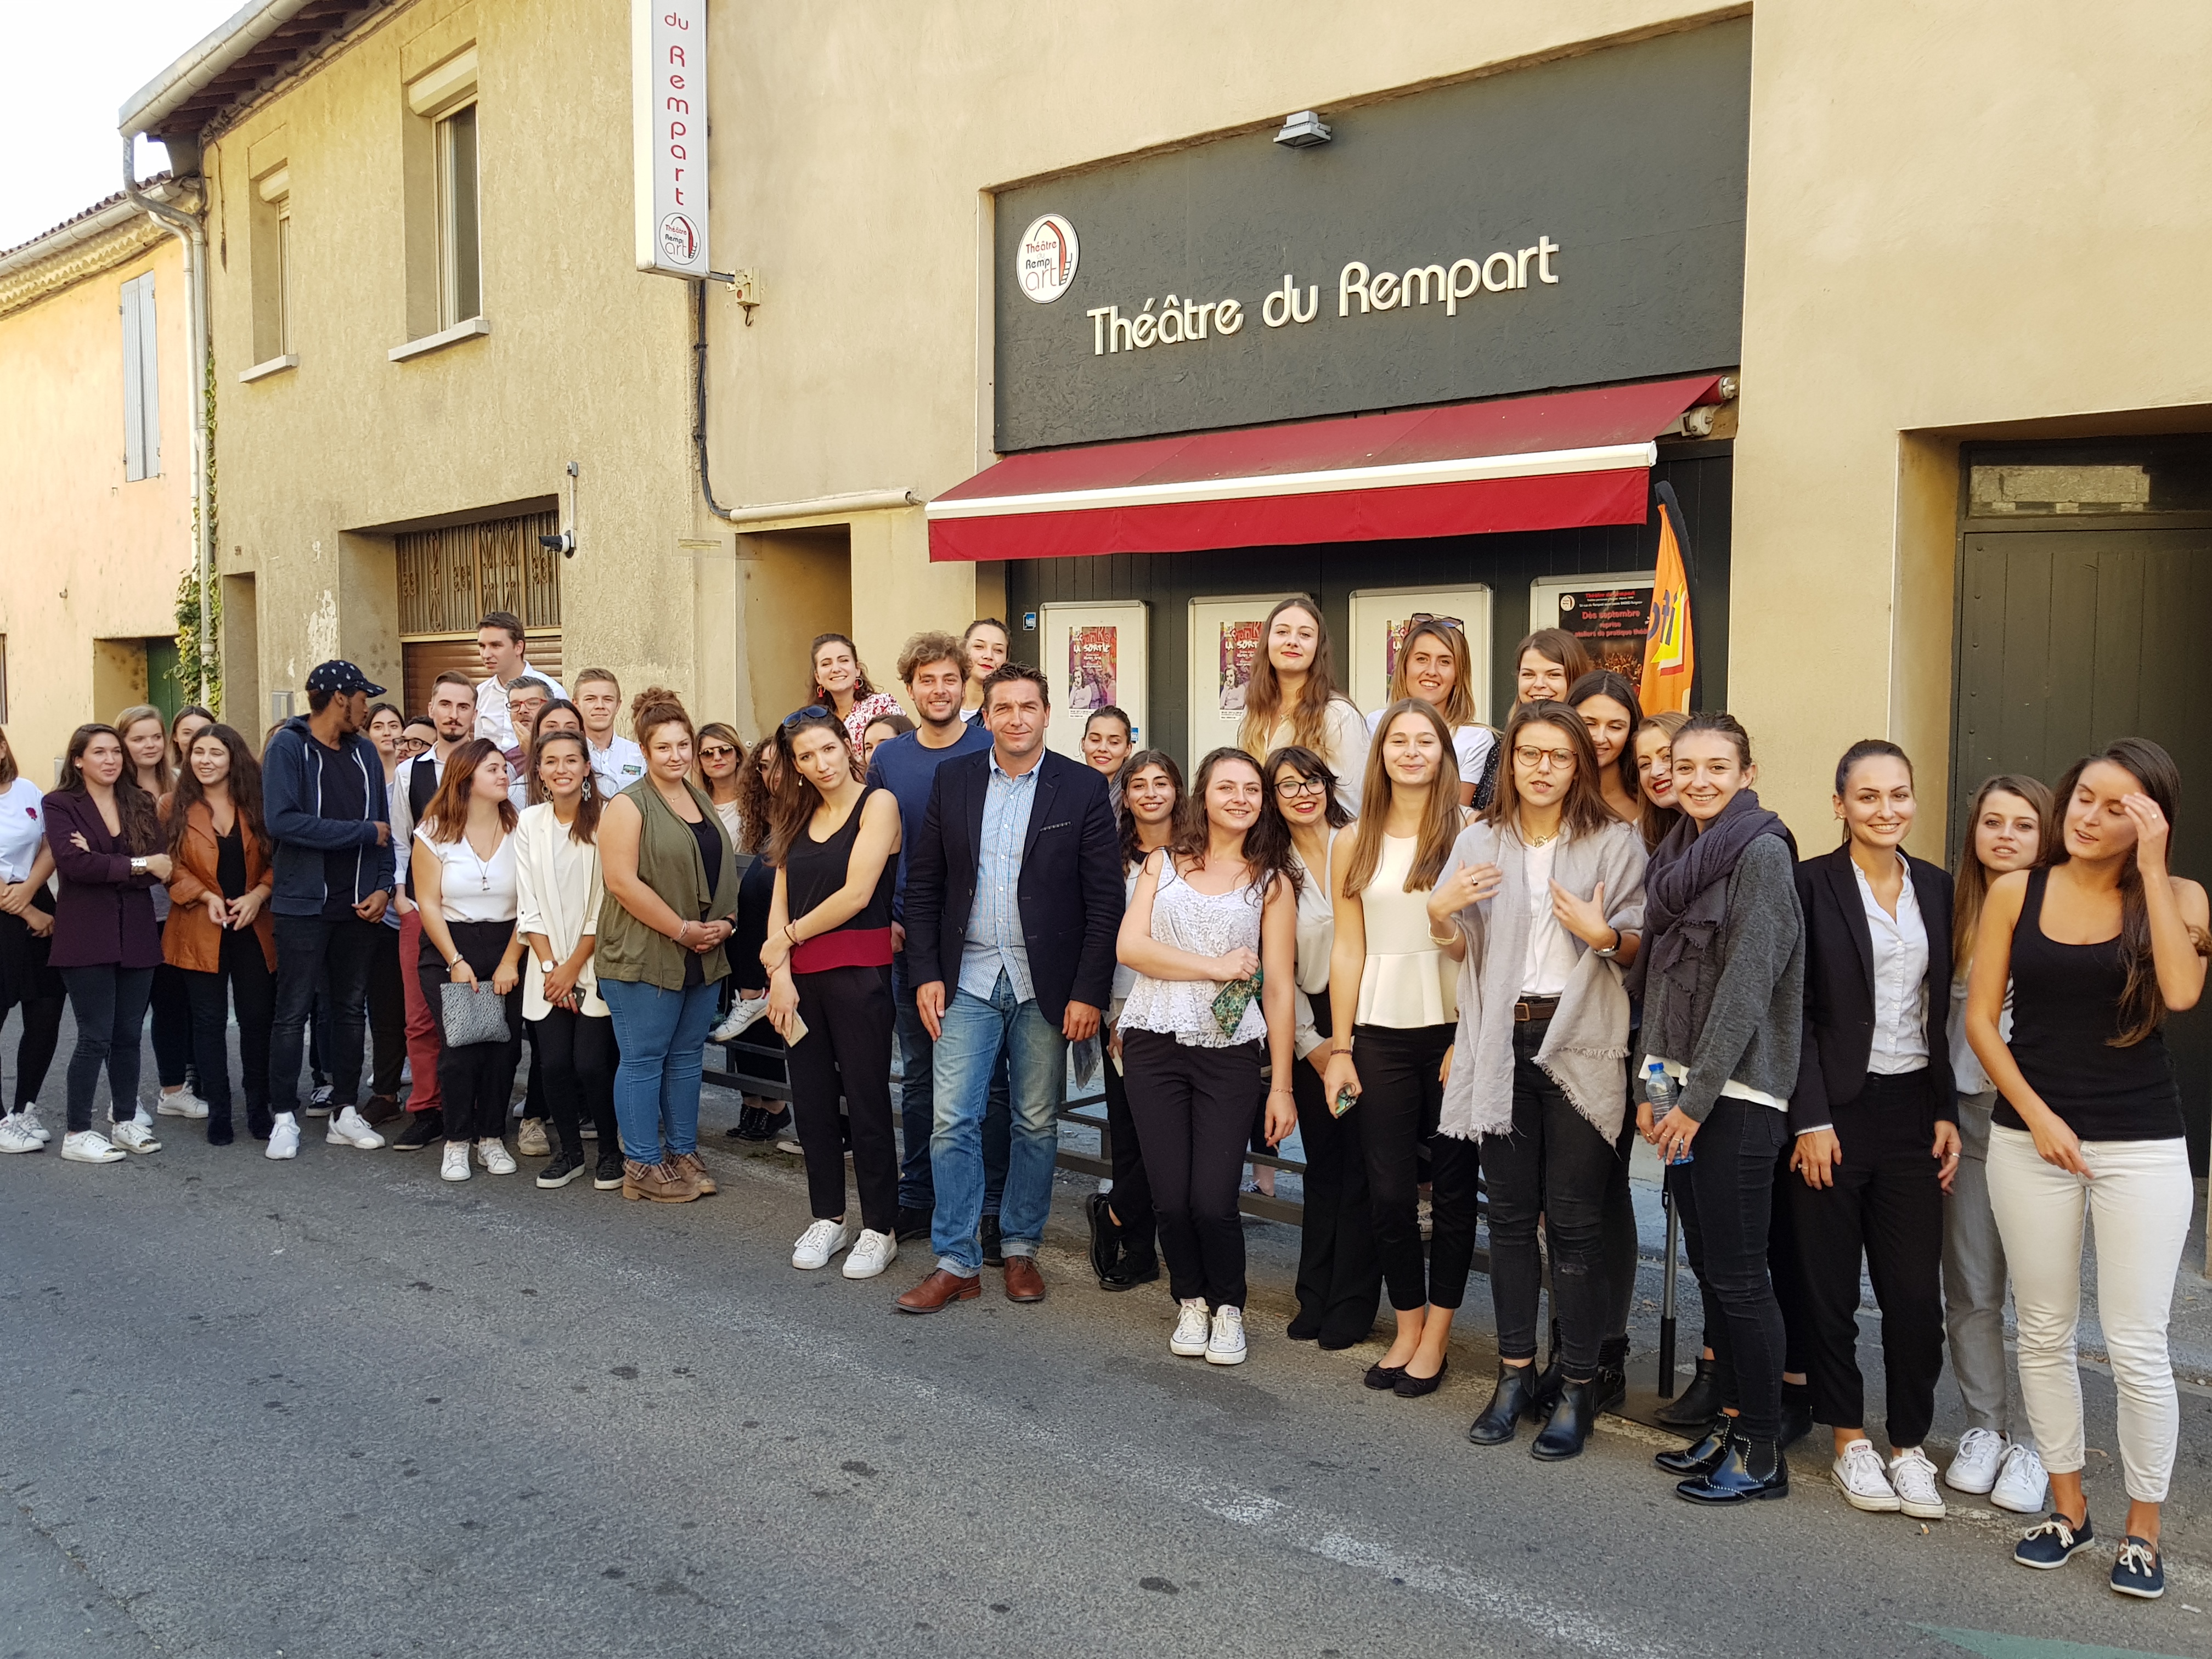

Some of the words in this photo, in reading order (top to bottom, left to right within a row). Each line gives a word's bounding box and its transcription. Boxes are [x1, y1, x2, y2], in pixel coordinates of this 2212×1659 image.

[664, 12, 689, 30] du
[667, 45, 689, 206] Rempart
[1026, 240, 1057, 254] Théâtre
[1026, 258, 1050, 269] Remp
[1025, 258, 1057, 291] art
[1087, 294, 1244, 356] Théâtre
[1262, 274, 1319, 328] du
[1339, 235, 1560, 317] Rempart
[1582, 611, 1597, 619] Dès
[1599, 610, 1640, 620] septembre
